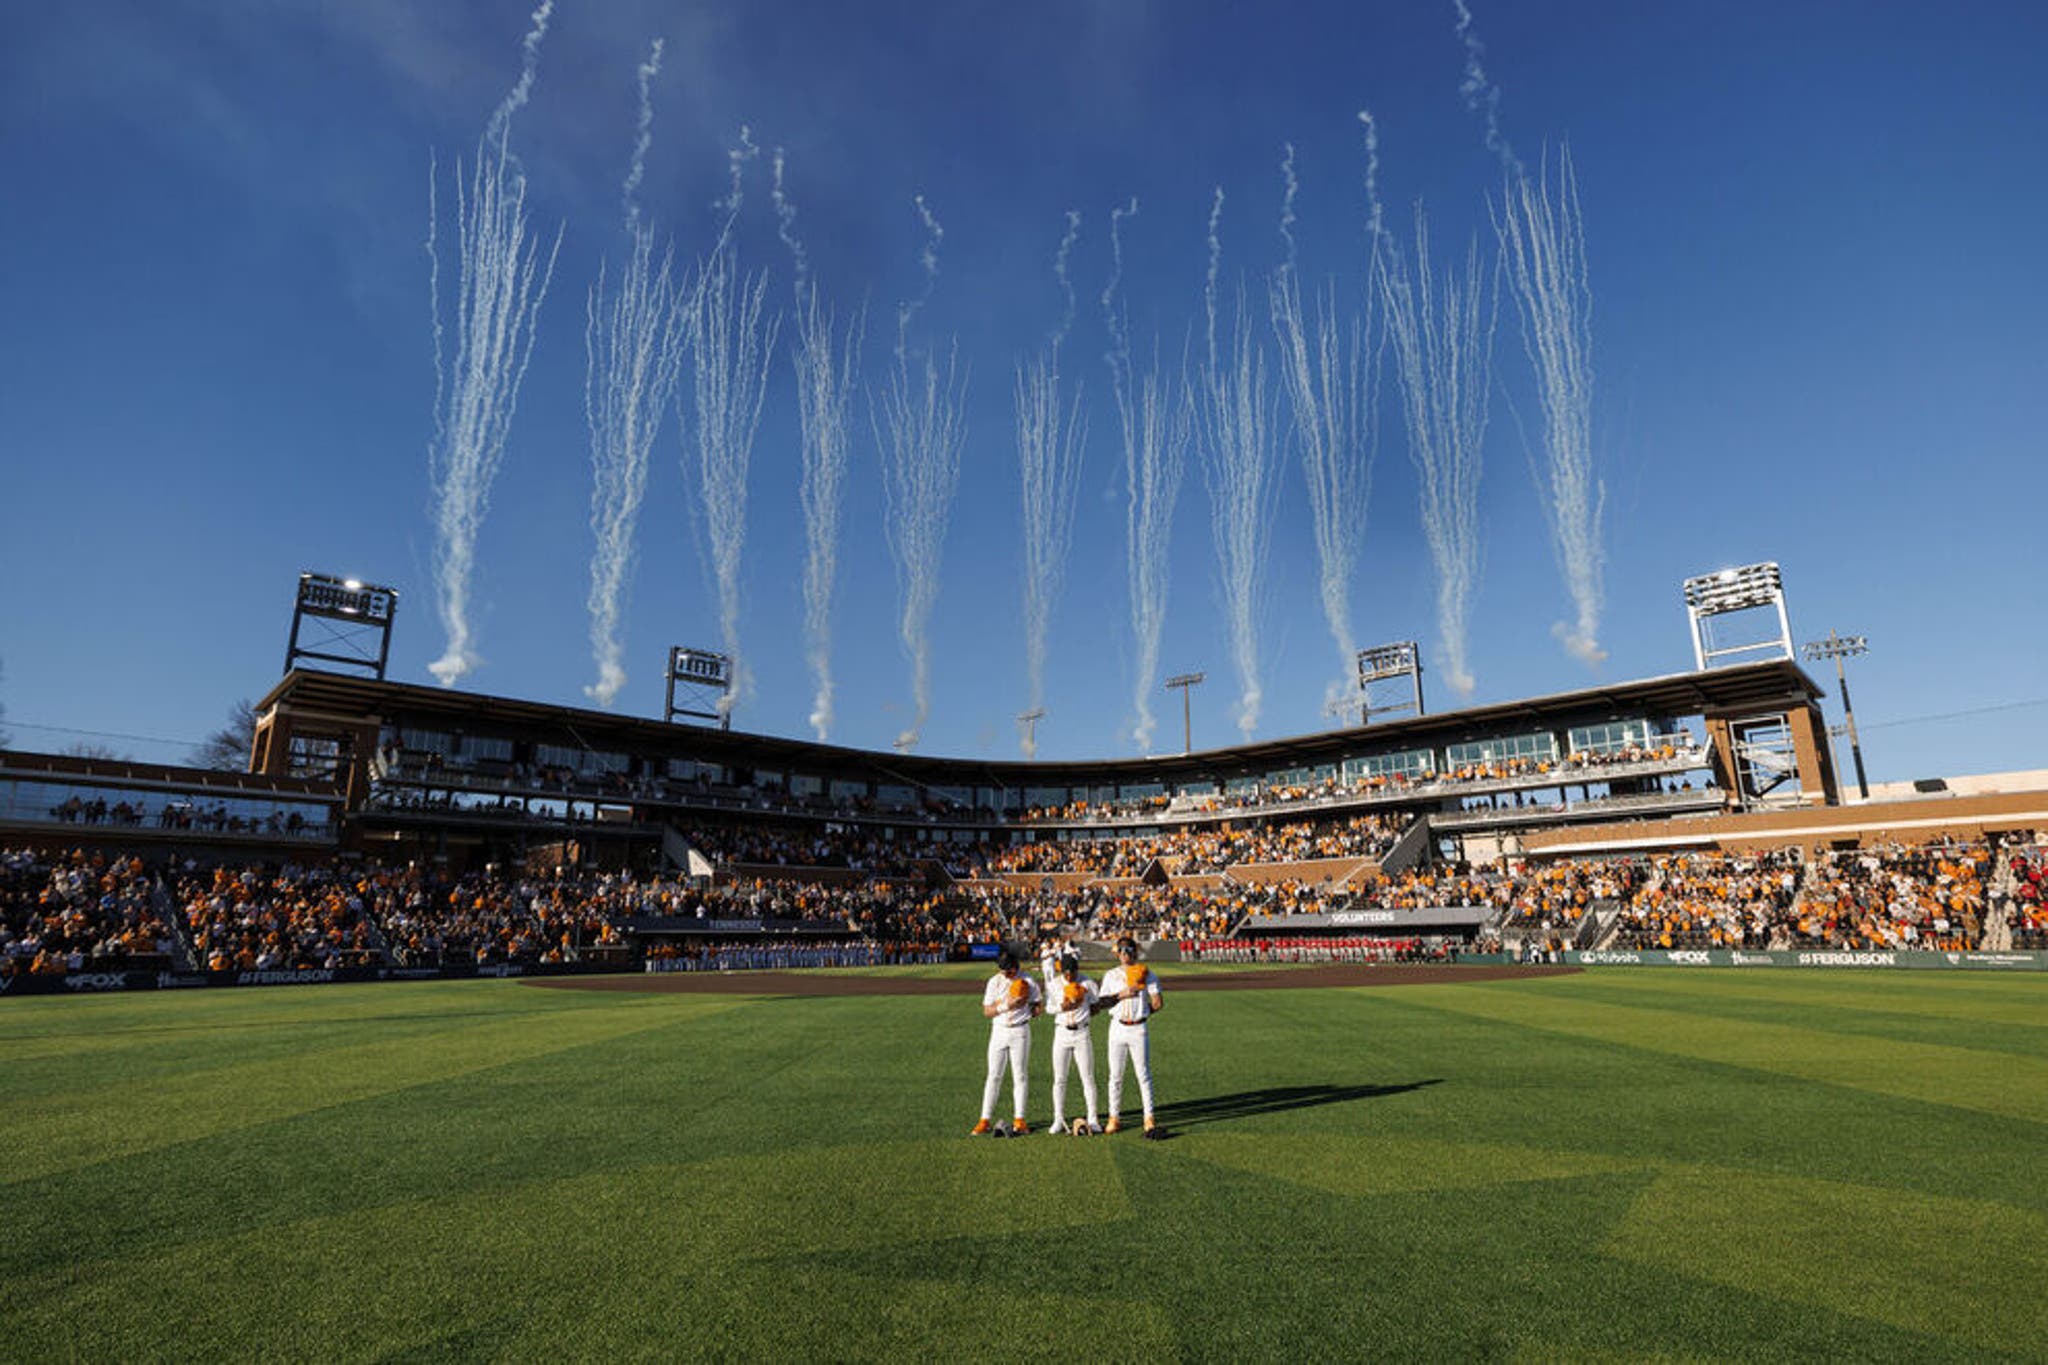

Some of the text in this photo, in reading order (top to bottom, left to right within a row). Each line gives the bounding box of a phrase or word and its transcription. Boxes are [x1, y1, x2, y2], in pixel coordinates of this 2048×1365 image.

[1331, 911, 1395, 923] VOLUNTEERS
[1679, 951, 1710, 965] FOX
[1812, 952, 1895, 965] FERGUSON
[82, 972, 127, 987] FOX
[253, 969, 334, 984] FERGUSON
